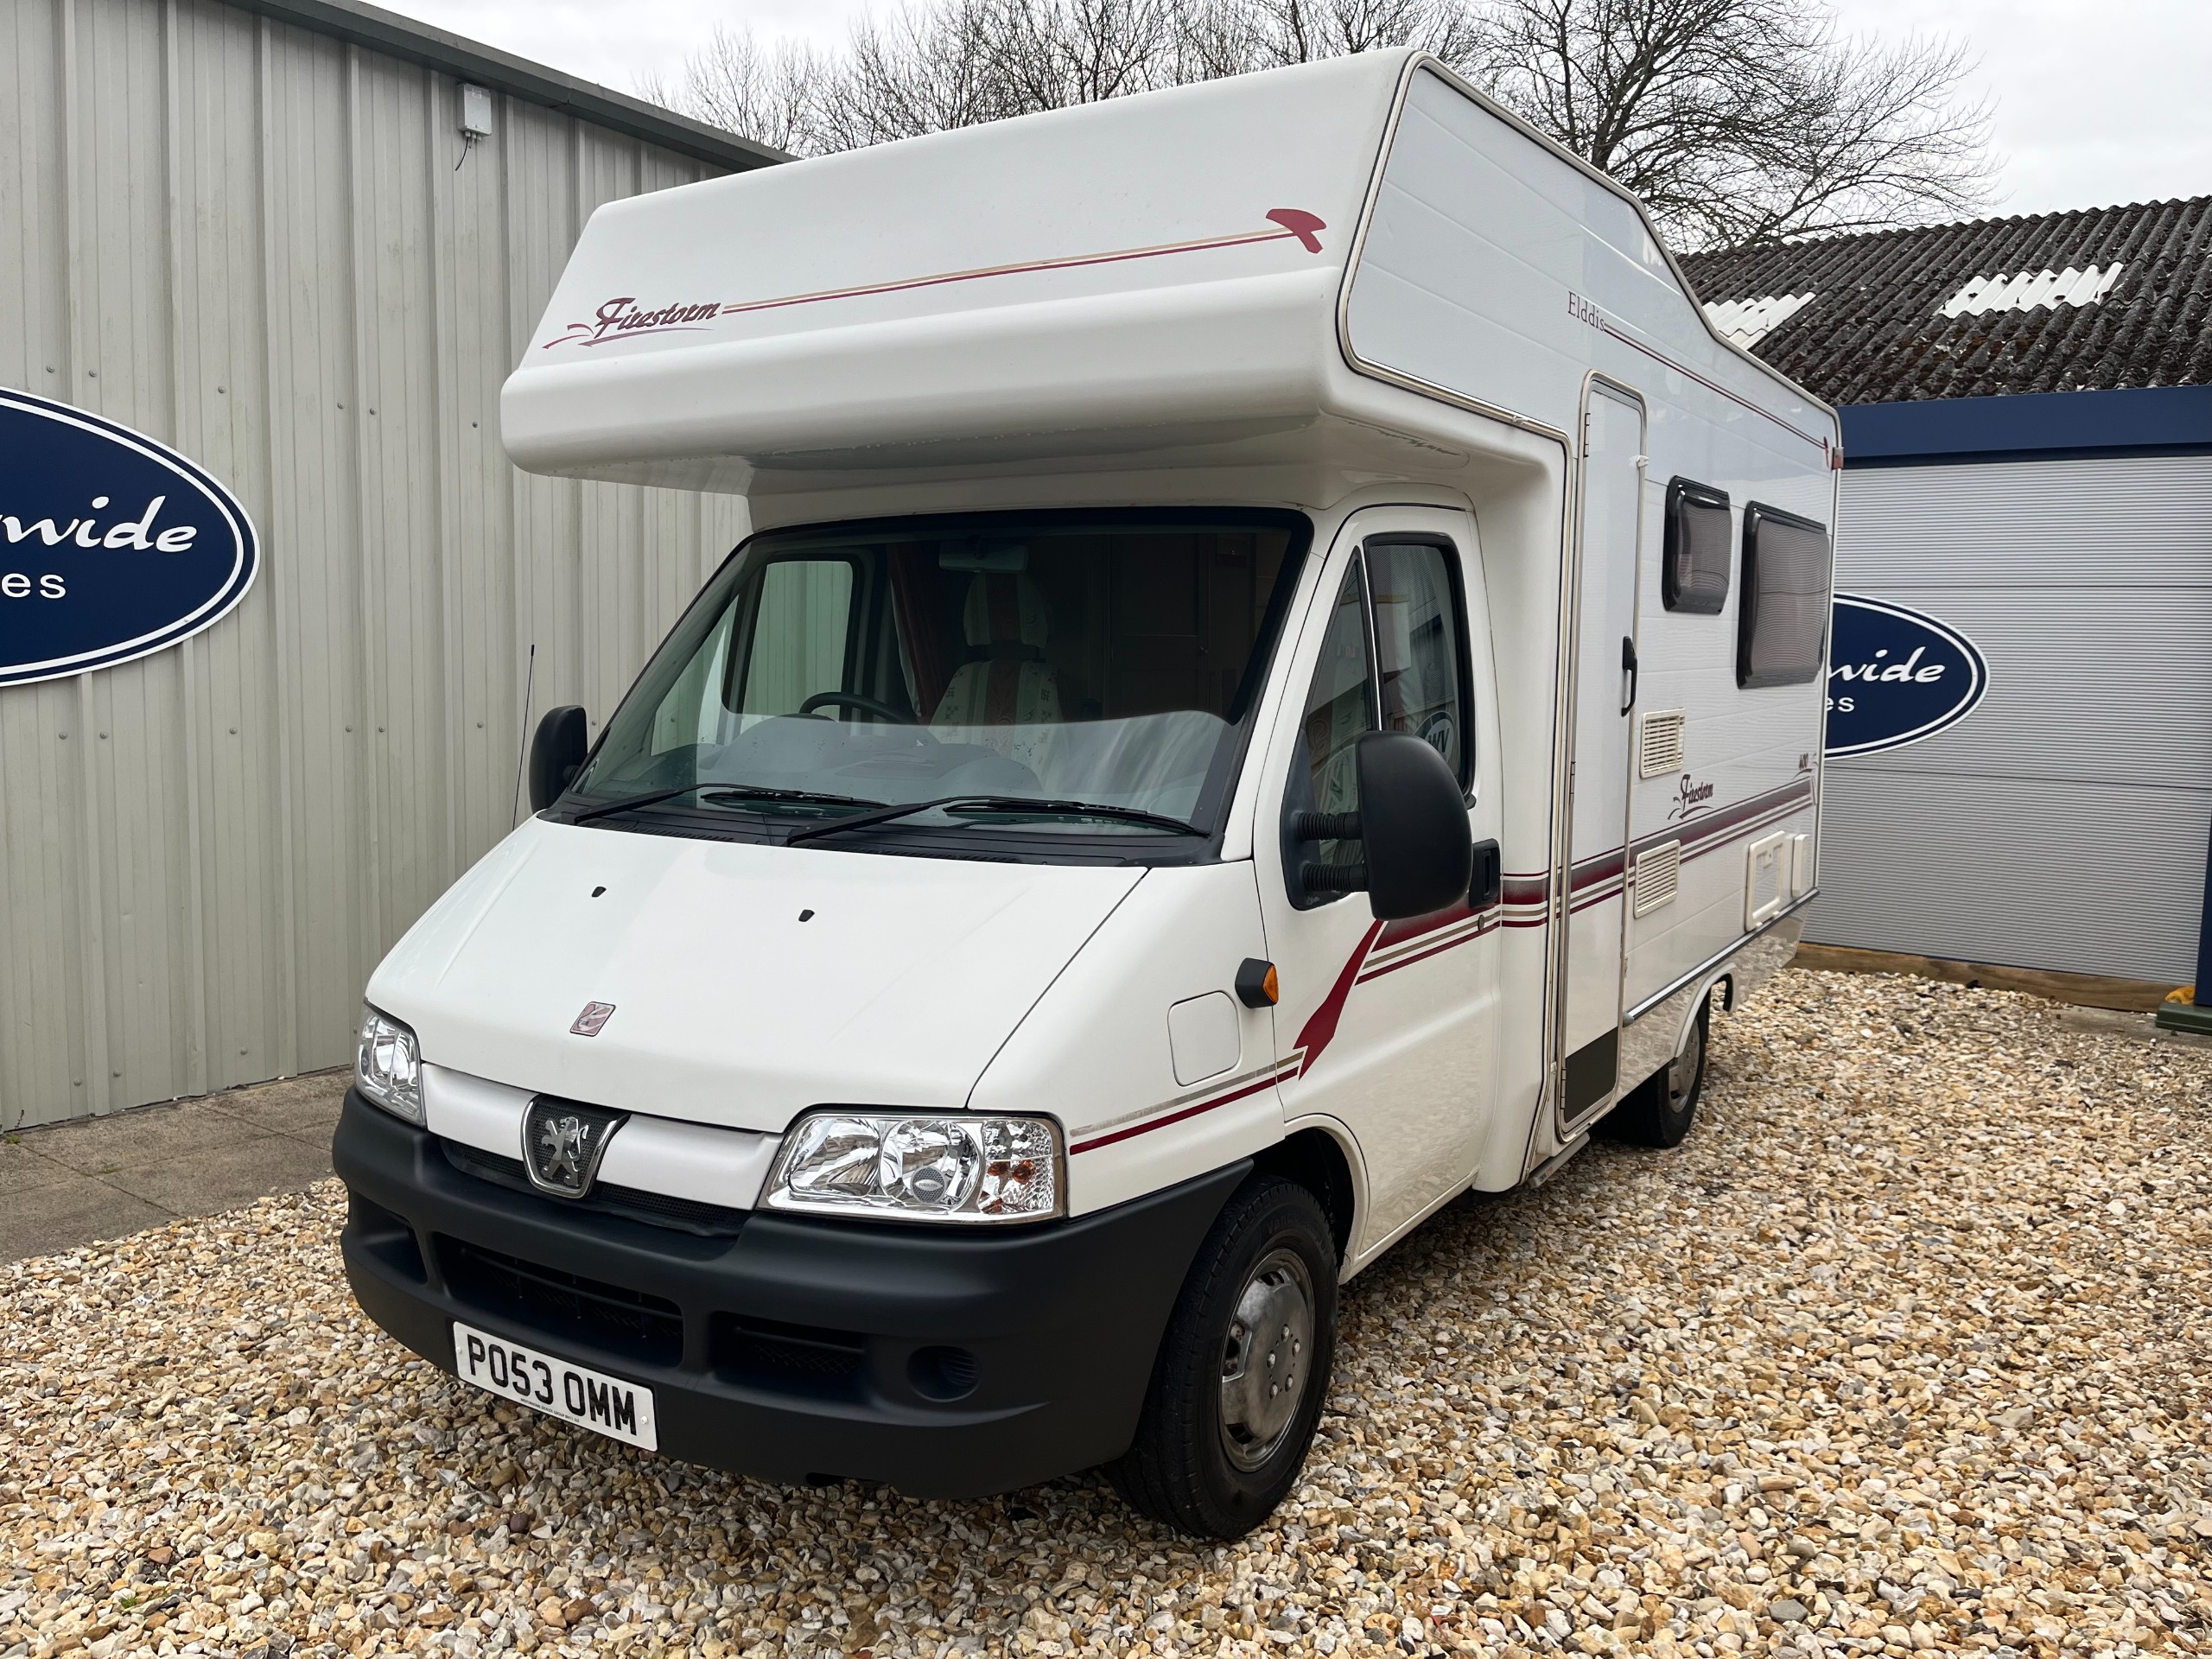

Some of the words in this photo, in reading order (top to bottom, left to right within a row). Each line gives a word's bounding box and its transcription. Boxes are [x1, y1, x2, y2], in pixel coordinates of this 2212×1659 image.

[594, 297, 721, 340] Firestorm
[1567, 290, 1605, 332] Elddis
[0, 495, 197, 552] wide
[1680, 773, 1714, 811] Firestorm
[467, 1333, 554, 1405] PO53
[563, 1370, 637, 1436] OMM
